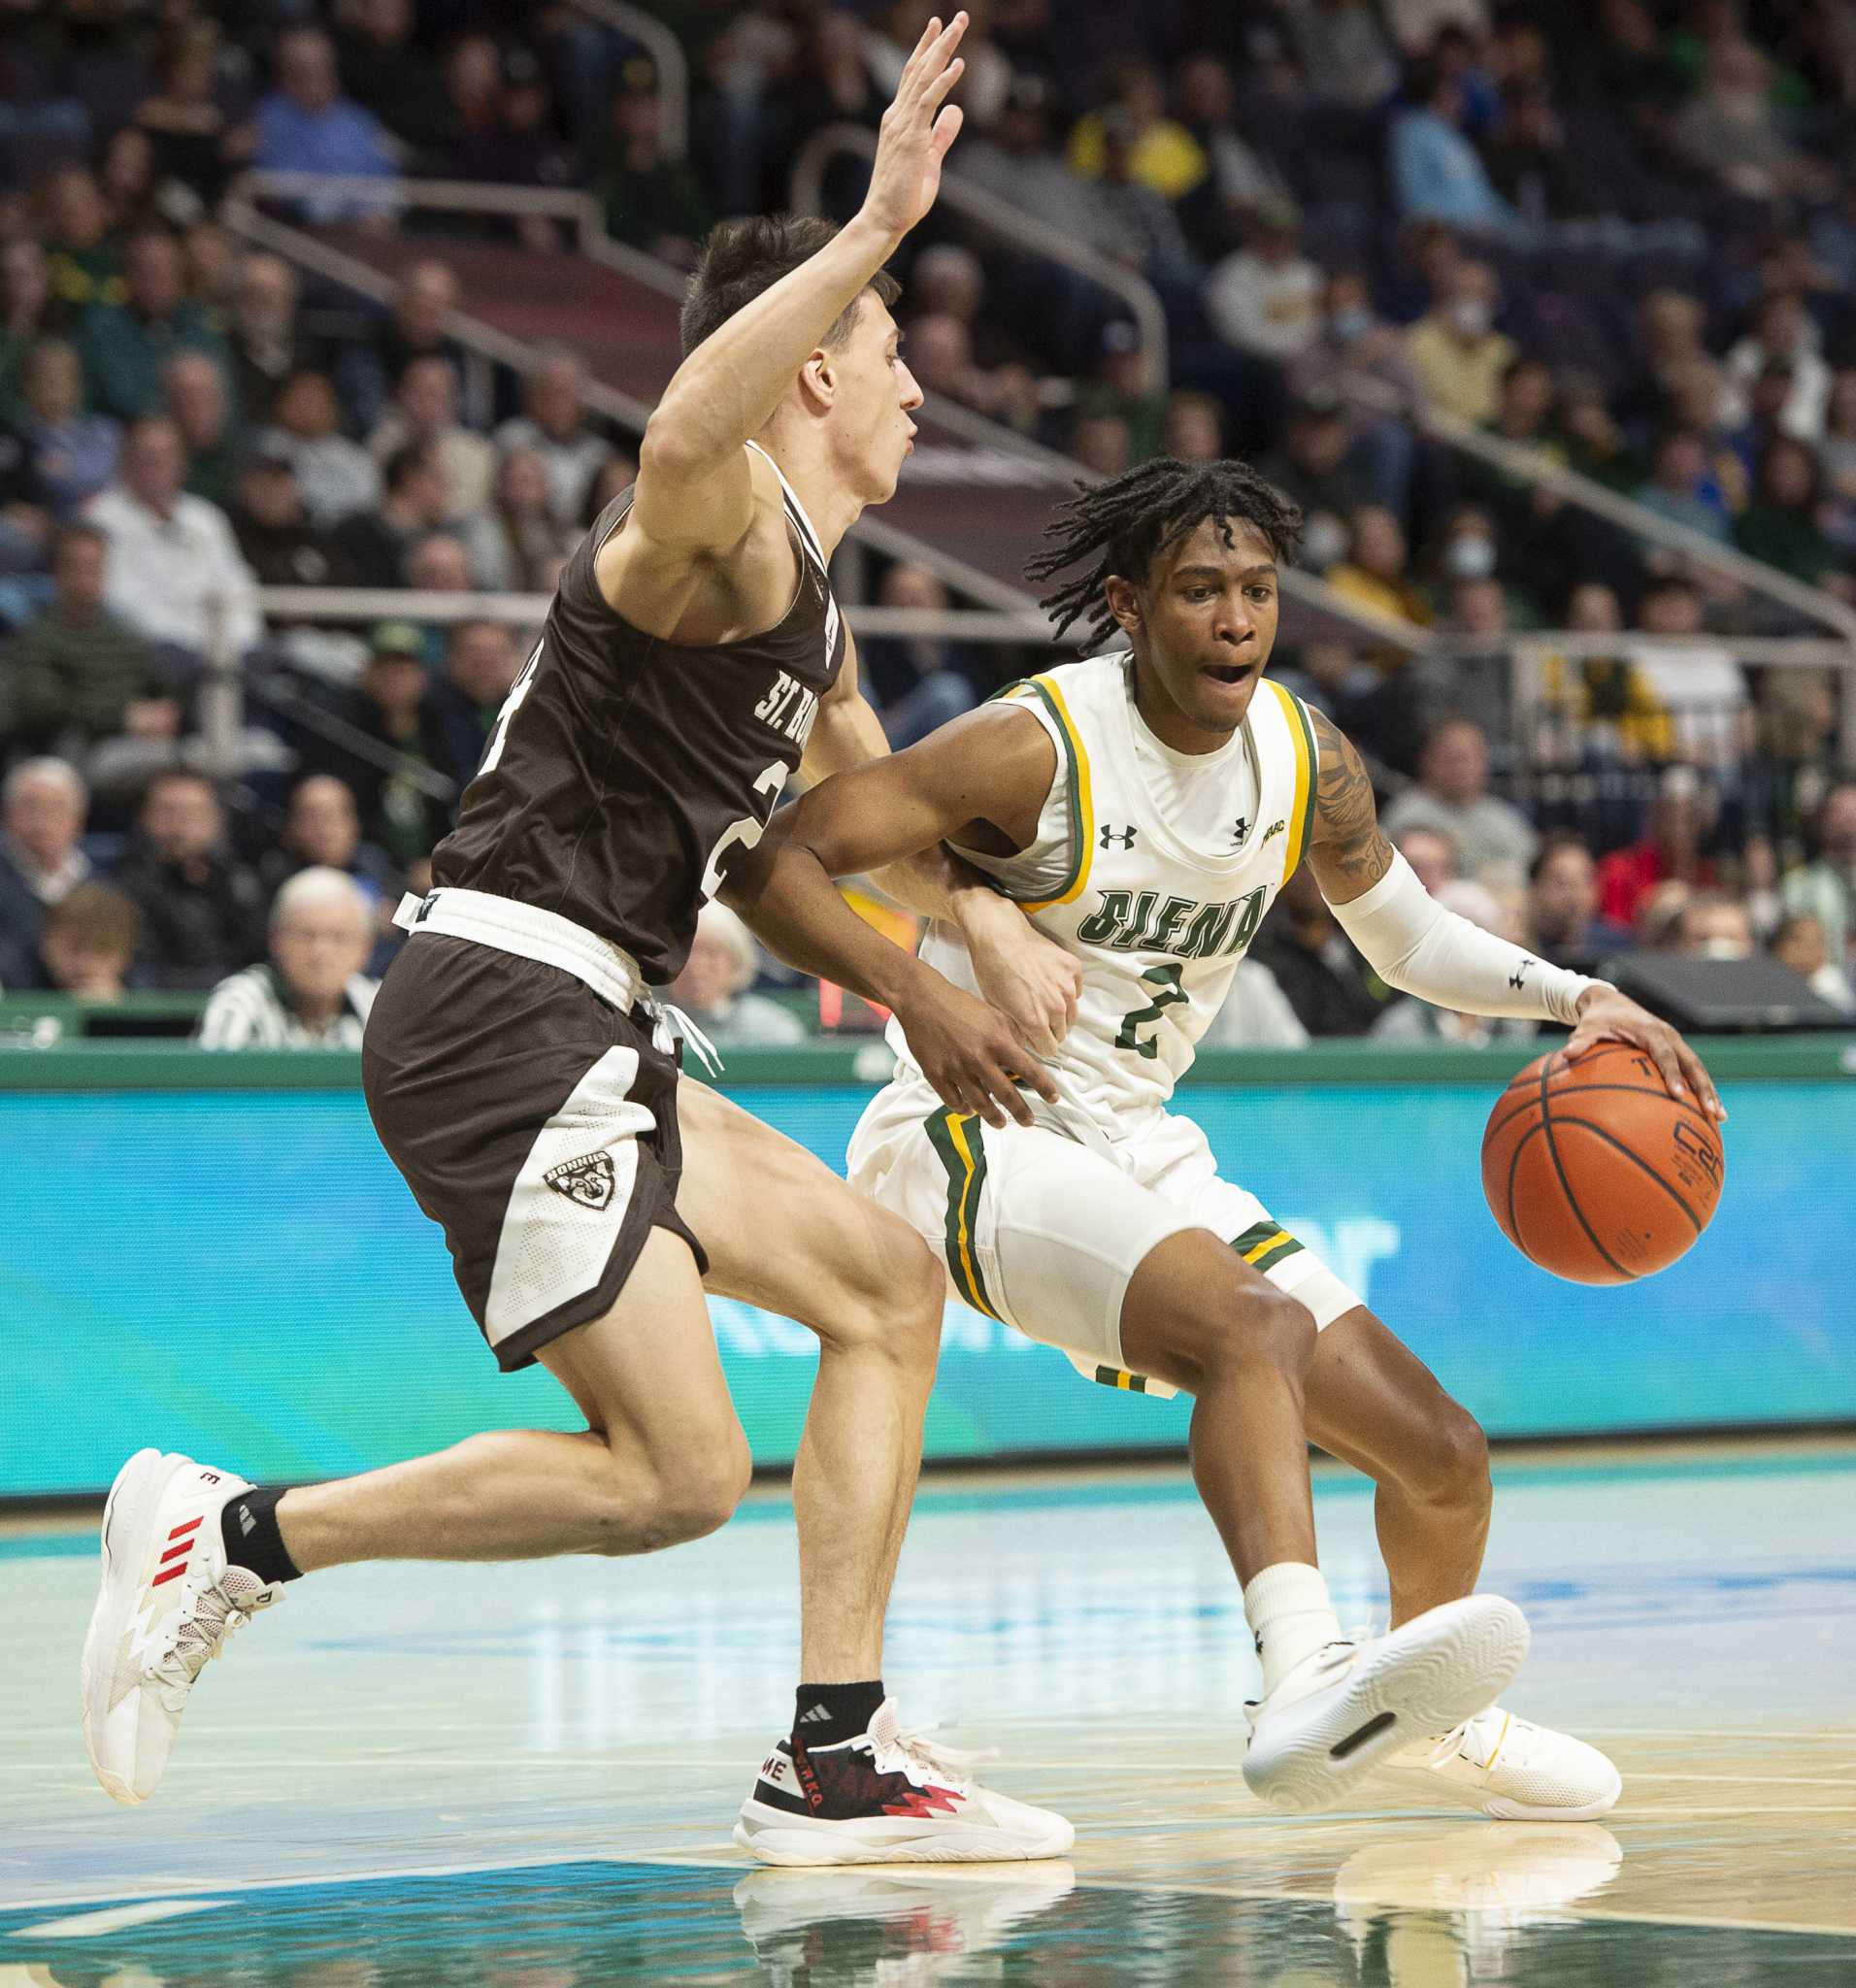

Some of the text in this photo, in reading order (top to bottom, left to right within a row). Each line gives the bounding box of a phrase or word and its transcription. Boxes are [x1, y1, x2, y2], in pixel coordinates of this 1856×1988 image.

[754, 670, 801, 730] ST.
[1077, 884, 1268, 960] SIENA
[1114, 962, 1190, 1060] 2
